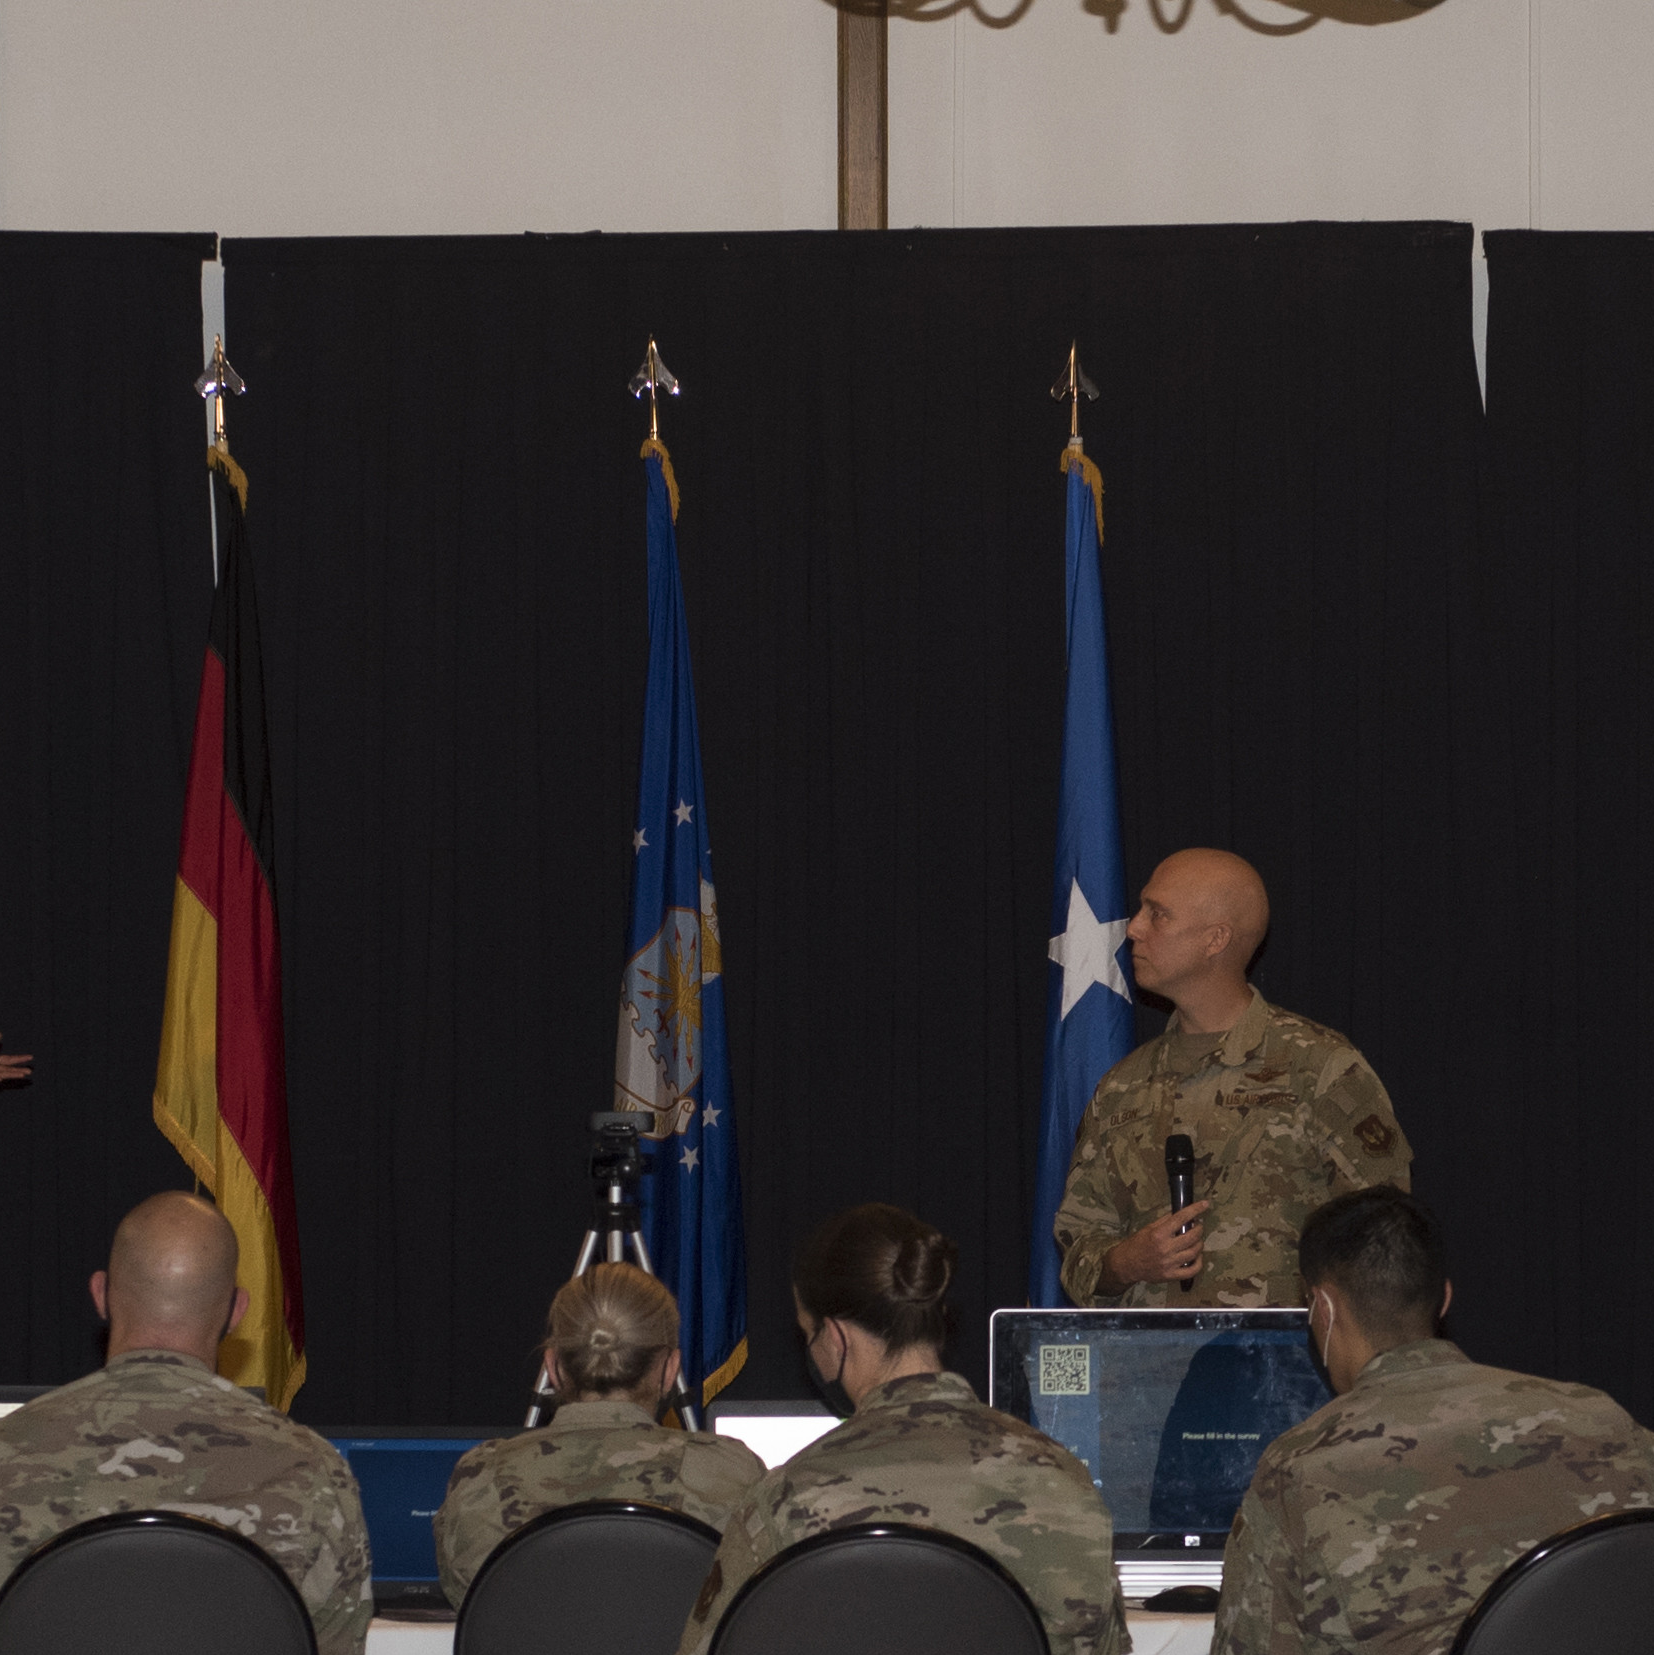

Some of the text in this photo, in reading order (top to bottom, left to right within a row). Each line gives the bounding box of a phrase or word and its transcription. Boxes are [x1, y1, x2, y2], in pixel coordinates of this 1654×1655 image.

[1110, 1108, 1139, 1126] OLSON
[1182, 1432, 1205, 1440] Please
[1224, 1432, 1236, 1440] the
[1237, 1433, 1261, 1441] survey
